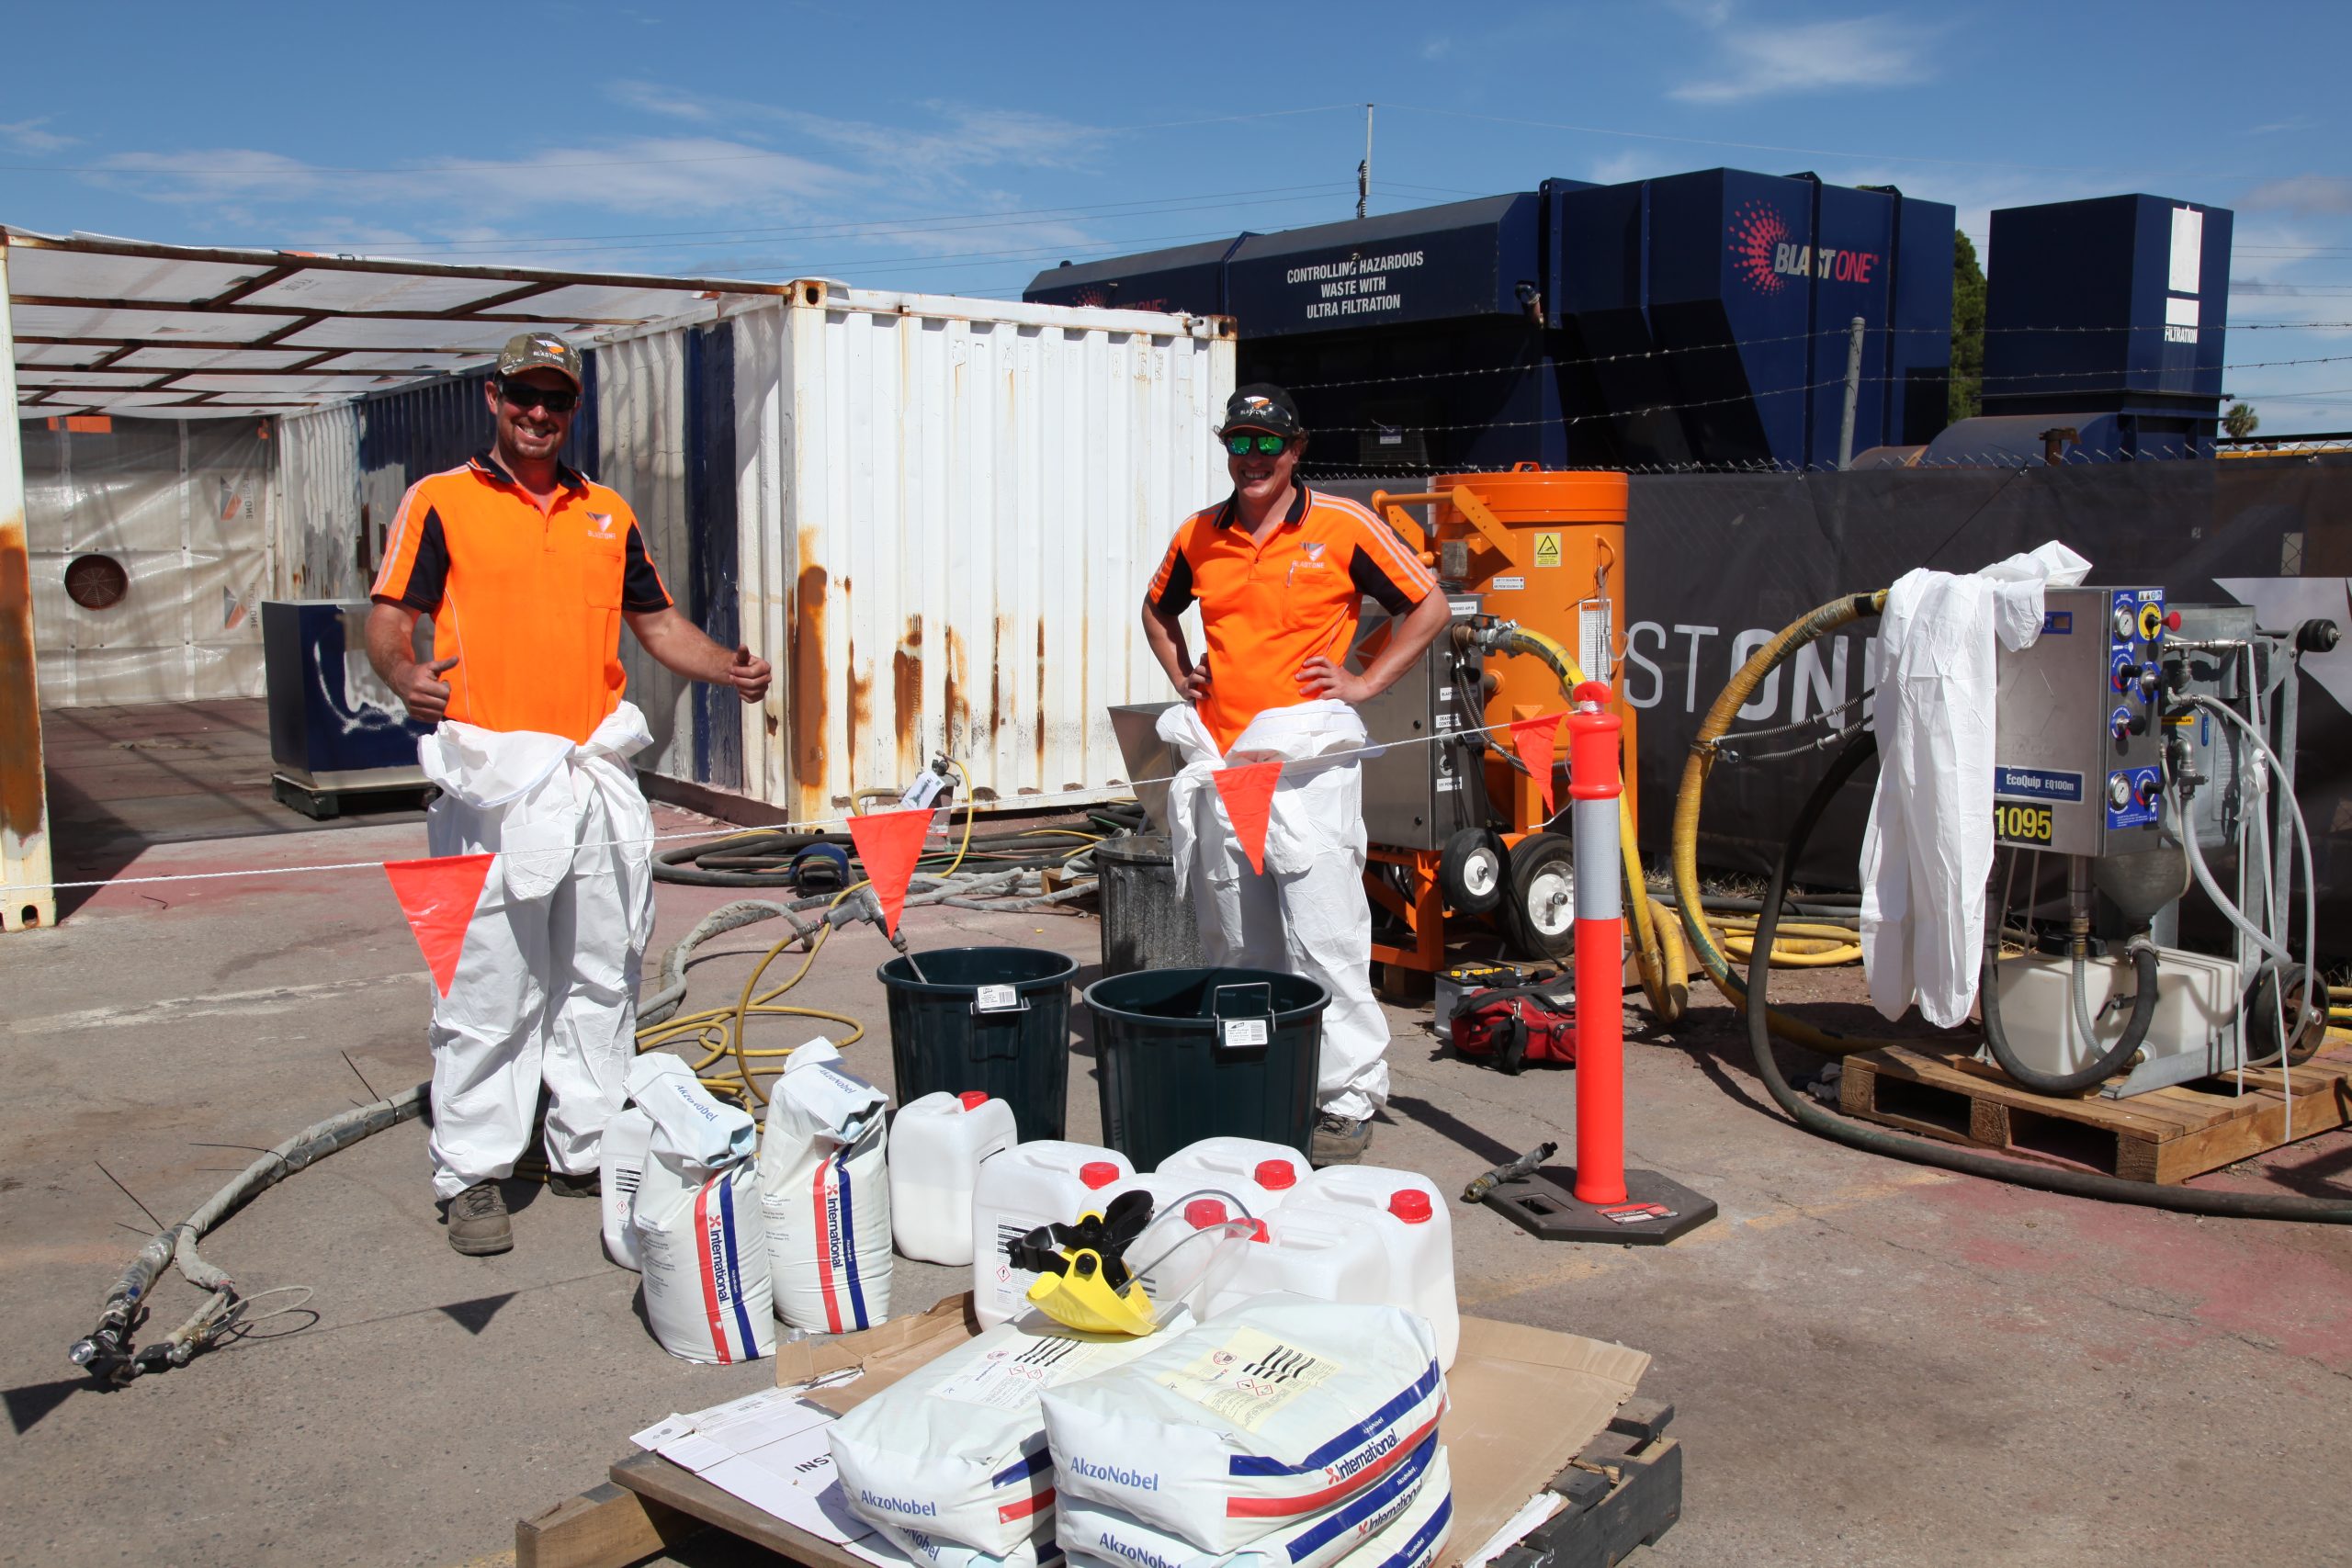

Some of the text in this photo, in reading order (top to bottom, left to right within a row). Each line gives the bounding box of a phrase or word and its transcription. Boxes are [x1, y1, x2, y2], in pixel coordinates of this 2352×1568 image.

[1287, 251, 1424, 284] CONTROLLING HAZARDOUS
[1321, 276, 1385, 298] WASTE WITH
[1306, 294, 1401, 319] ULTRA FILTRATION
[2165, 326, 2198, 344] FILTRATION
[534, 351, 564, 363] BLASTONE
[587, 530, 616, 539] BLASTONE
[2006, 773, 2075, 791] EcoQuip EQ100m
[1995, 807, 2052, 840] 1095
[827, 1198, 843, 1269] International
[710, 1230, 730, 1303] International
[1335, 1428, 1398, 1481] International
[1070, 1456, 1159, 1492] AkzoNobel
[861, 1490, 936, 1517] AkzoNobel
[1369, 1478, 1423, 1531] International
[1099, 1531, 1182, 1568] AkzoNob
